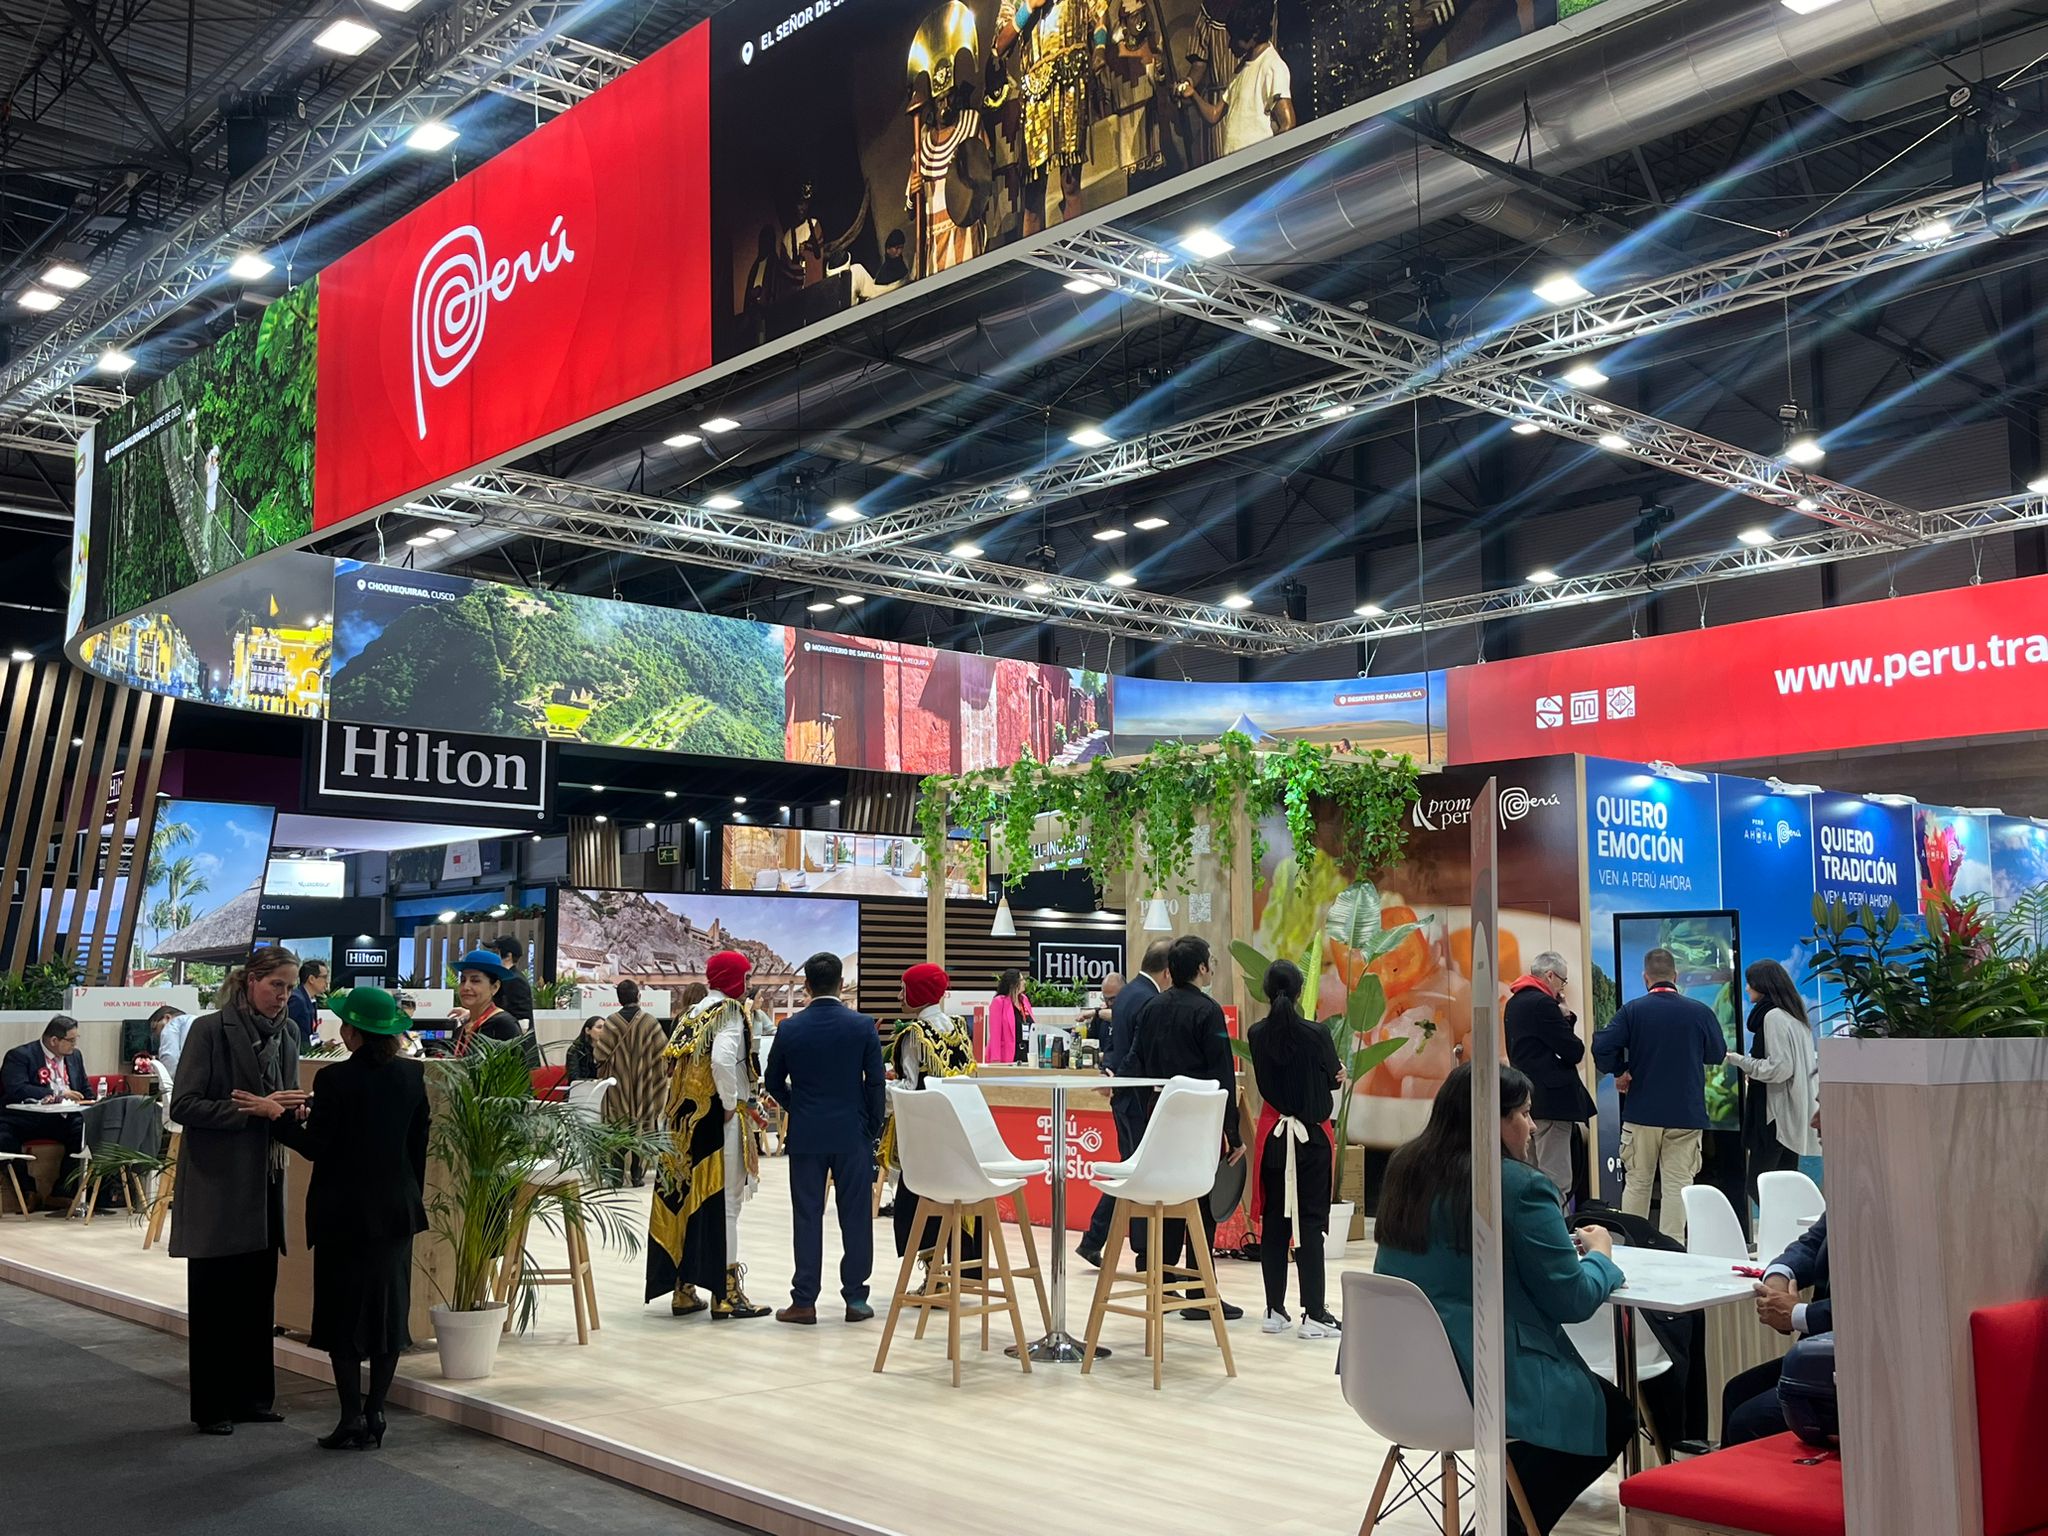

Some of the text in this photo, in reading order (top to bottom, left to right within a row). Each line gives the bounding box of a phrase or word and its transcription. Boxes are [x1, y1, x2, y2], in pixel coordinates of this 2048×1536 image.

[761, 0, 832, 50] EL SEÑOR DE
[412, 215, 575, 440] Perú
[110, 441, 125, 459] PUERTO
[150, 416, 165, 432] MADRE
[171, 404, 182, 420] DIOS
[368, 582, 456, 602] CHOQUEQUIRAO, CUSCO
[812, 643, 930, 667] MONASTERIO DE SANTA CATALINA, AREQUIPA
[1774, 634, 2048, 694] www.peru.tra
[1347, 694, 1375, 703] DESIERTO
[1376, 693, 1384, 701] DE
[340, 725, 528, 791] Hilton
[1427, 797, 1471, 819] prom
[1441, 811, 1472, 831] per
[1499, 786, 1561, 830] Perú
[1596, 795, 1667, 830] QUIERO
[1597, 829, 1684, 864] EMOCIÓN
[1820, 825, 1874, 855] QUIERO
[1598, 868, 1692, 891] VEN A PERÚ AHORA
[1821, 855, 1897, 886] TRADICIÓN
[1841, 891, 1848, 905] A
[349, 952, 384, 964] Hilton
[1045, 952, 1115, 979] Hilton
[74, 988, 88, 997] 17
[583, 991, 593, 999] 21
